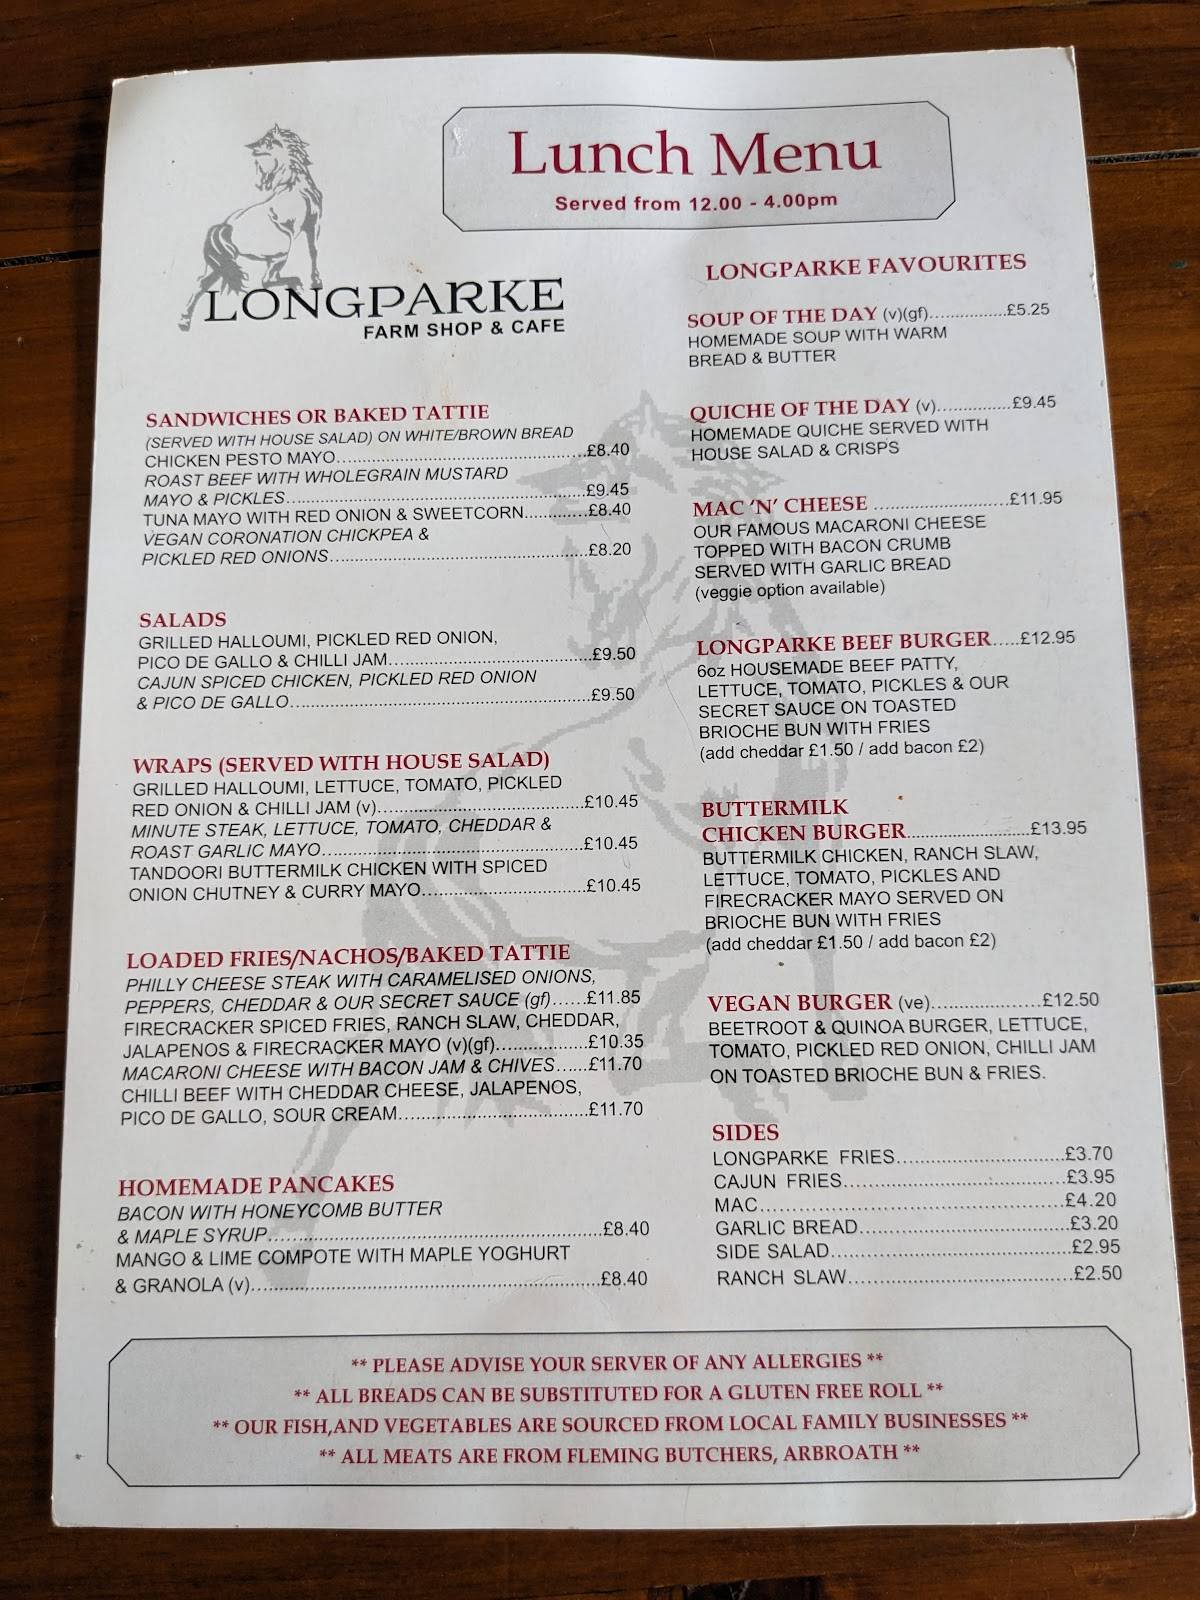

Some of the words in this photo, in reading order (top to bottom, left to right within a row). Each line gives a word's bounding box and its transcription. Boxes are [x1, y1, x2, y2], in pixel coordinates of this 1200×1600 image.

[508, 129, 693, 175] Lunch
[710, 132, 882, 175] Menu
[555, 195, 626, 211] Served
[633, 195, 680, 211] from
[689, 196, 741, 211] 12.00
[763, 193, 837, 210] 4.00pm
[706, 259, 861, 280] LONGPARKE
[867, 253, 1026, 274] FAVOURITES
[205, 277, 564, 322] LONGPARKE
[687, 311, 744, 328] SOUP
[749, 310, 777, 325] OF
[782, 308, 826, 324] THE
[831, 306, 877, 322] DAY
[883, 306, 928, 323] (v)(gf)
[1007, 302, 1050, 316] £5.25
[364, 323, 418, 339] FARM
[426, 321, 482, 337] SHOP
[490, 320, 503, 335] &
[511, 318, 565, 334] CAFE
[688, 331, 787, 348] HOMEMADE
[792, 330, 840, 344] SOUP
[844, 328, 888, 342] WITH
[893, 325, 947, 340] WARM
[146, 410, 291, 428] SANDWICHES
[296, 409, 327, 424] OR
[333, 406, 407, 423] BAKED
[412, 404, 489, 420] TATTIE
[145, 436, 213, 451] (SERVED
[217, 434, 256, 447] WITH
[259, 433, 314, 446] HOUSE
[318, 431, 372, 446] SALAD)
[377, 430, 400, 443] ON
[405, 427, 517, 442] WHITE/BROWN
[521, 426, 573, 439] BREAD
[691, 425, 791, 442] HOMEMADE
[796, 422, 863, 438] QUICHE
[869, 420, 939, 435] SERVED
[944, 418, 988, 432] WITH
[691, 446, 752, 462] HOUSE
[757, 444, 814, 459] SALAD
[818, 443, 830, 457] &
[835, 440, 899, 456] CRISPS
[144, 473, 204, 487] ROAST
[207, 472, 253, 486] BEEF
[257, 471, 300, 485] WITH
[305, 467, 421, 483] WHOLEGRAIN
[425, 466, 508, 481] MUSTARD
[692, 500, 744, 517] MAC
[784, 495, 867, 513] CHEESE
[1009, 491, 1063, 505] £11.95
[693, 524, 732, 539] OUR
[737, 521, 810, 537] FAMOUS
[815, 518, 909, 534] MACARONI
[914, 515, 986, 531] CHEESE
[693, 543, 765, 559] TOPPED
[769, 541, 814, 556] WITH
[819, 538, 881, 554] BACON
[887, 536, 951, 551] CRUMB
[694, 563, 765, 579] SERVED
[770, 561, 814, 576] WITH
[820, 558, 885, 574] GARLIC
[891, 556, 951, 572] BREAD
[139, 611, 226, 628] SALADS
[138, 635, 212, 649] GRILLED
[218, 633, 310, 649] HALLOUMI,
[316, 632, 390, 646] PICKLED
[395, 631, 431, 645] RED
[436, 630, 497, 645] ONION,
[696, 635, 836, 656] LONGPARKE
[841, 634, 893, 651] BEEF
[899, 631, 991, 649] BURGER
[1020, 630, 1075, 645] £12.95
[697, 664, 726, 678] 6oz
[730, 659, 844, 677] HOUSEMADE
[849, 658, 895, 673] BEEF
[901, 656, 957, 671] PATTY,
[137, 676, 196, 690] CAJUN
[201, 675, 266, 689] SPICED
[271, 673, 352, 688] CHICKEN,
[359, 672, 433, 686] PICKLED
[438, 671, 475, 685] RED
[480, 669, 537, 684] ONION
[698, 703, 770, 719] SECRET
[774, 701, 835, 716] SAUCE
[840, 700, 867, 714] ON
[871, 697, 956, 713] TOASTED
[133, 757, 212, 774] WRAPS
[218, 756, 313, 777] (SERVED
[319, 754, 379, 771] WITH
[385, 753, 462, 770] HOUSE
[468, 750, 549, 771] SALAD)
[701, 798, 848, 818] BUTTERMILK
[702, 825, 805, 843] CHICKEN
[812, 822, 905, 840] BURGER
[1030, 820, 1087, 835] £13.95
[703, 849, 817, 866] BUTTERMILK
[821, 848, 907, 863] CHICKEN,
[913, 846, 978, 861] RANCH
[983, 845, 1038, 860] SLAW,
[129, 865, 222, 880] TANDOORI
[228, 863, 342, 879] BUTTERMILK
[347, 861, 426, 877] CHICKEN
[431, 860, 476, 875] WITH
[482, 858, 547, 874] SPICED
[704, 892, 834, 908] FIRECRACKER
[839, 890, 891, 906] MAYO
[896, 889, 971, 905] SERVED
[976, 888, 1003, 903] ON
[705, 914, 786, 930] BRIOCHE
[792, 913, 830, 928] BUN
[835, 912, 881, 927] WITH
[888, 911, 941, 926] FRIES
[127, 951, 224, 969] LOADED
[230, 945, 484, 970] FRIES/NACHOS/BAKED
[489, 943, 570, 961] TATTIE
[125, 977, 188, 992] PHILLY
[192, 975, 266, 992] CHEESE
[271, 974, 331, 990] STEAK
[337, 973, 383, 988] WITH
[387, 970, 516, 987] CARAMELISED
[522, 968, 595, 985] ONIONS,
[707, 994, 790, 1012] VEGAN
[796, 993, 893, 1011] BURGER
[898, 994, 930, 1013] (ve)
[1042, 991, 1099, 1007] £12.50
[708, 1042, 790, 1059] TOMATO,
[796, 1041, 874, 1057] PICKLED
[880, 1041, 919, 1056] RED
[924, 1040, 989, 1056] ONION,
[996, 1039, 1052, 1055] CHILLI
[1059, 1038, 1095, 1054] JAM
[712, 1123, 779, 1141] SIDES
[713, 1149, 828, 1166] LONGPARKE
[839, 1148, 894, 1164] FRIES
[1064, 1145, 1113, 1161] £3.70
[118, 1177, 262, 1197] HOMEMADE
[268, 1174, 394, 1194] PANCAKES
[117, 1205, 184, 1221] BACON
[190, 1204, 237, 1220] WITH
[241, 1202, 363, 1219] HONEYCOMB
[368, 1200, 443, 1217] BUTTER
[372, 1357, 444, 1373] PLEASE
[450, 1356, 524, 1372] ADVISE
[529, 1356, 585, 1372] YOUR
[591, 1355, 667, 1371] SERVER
[672, 1355, 699, 1370] OF
[704, 1354, 746, 1370] ANY
[752, 1352, 862, 1369] ALLERGIES
